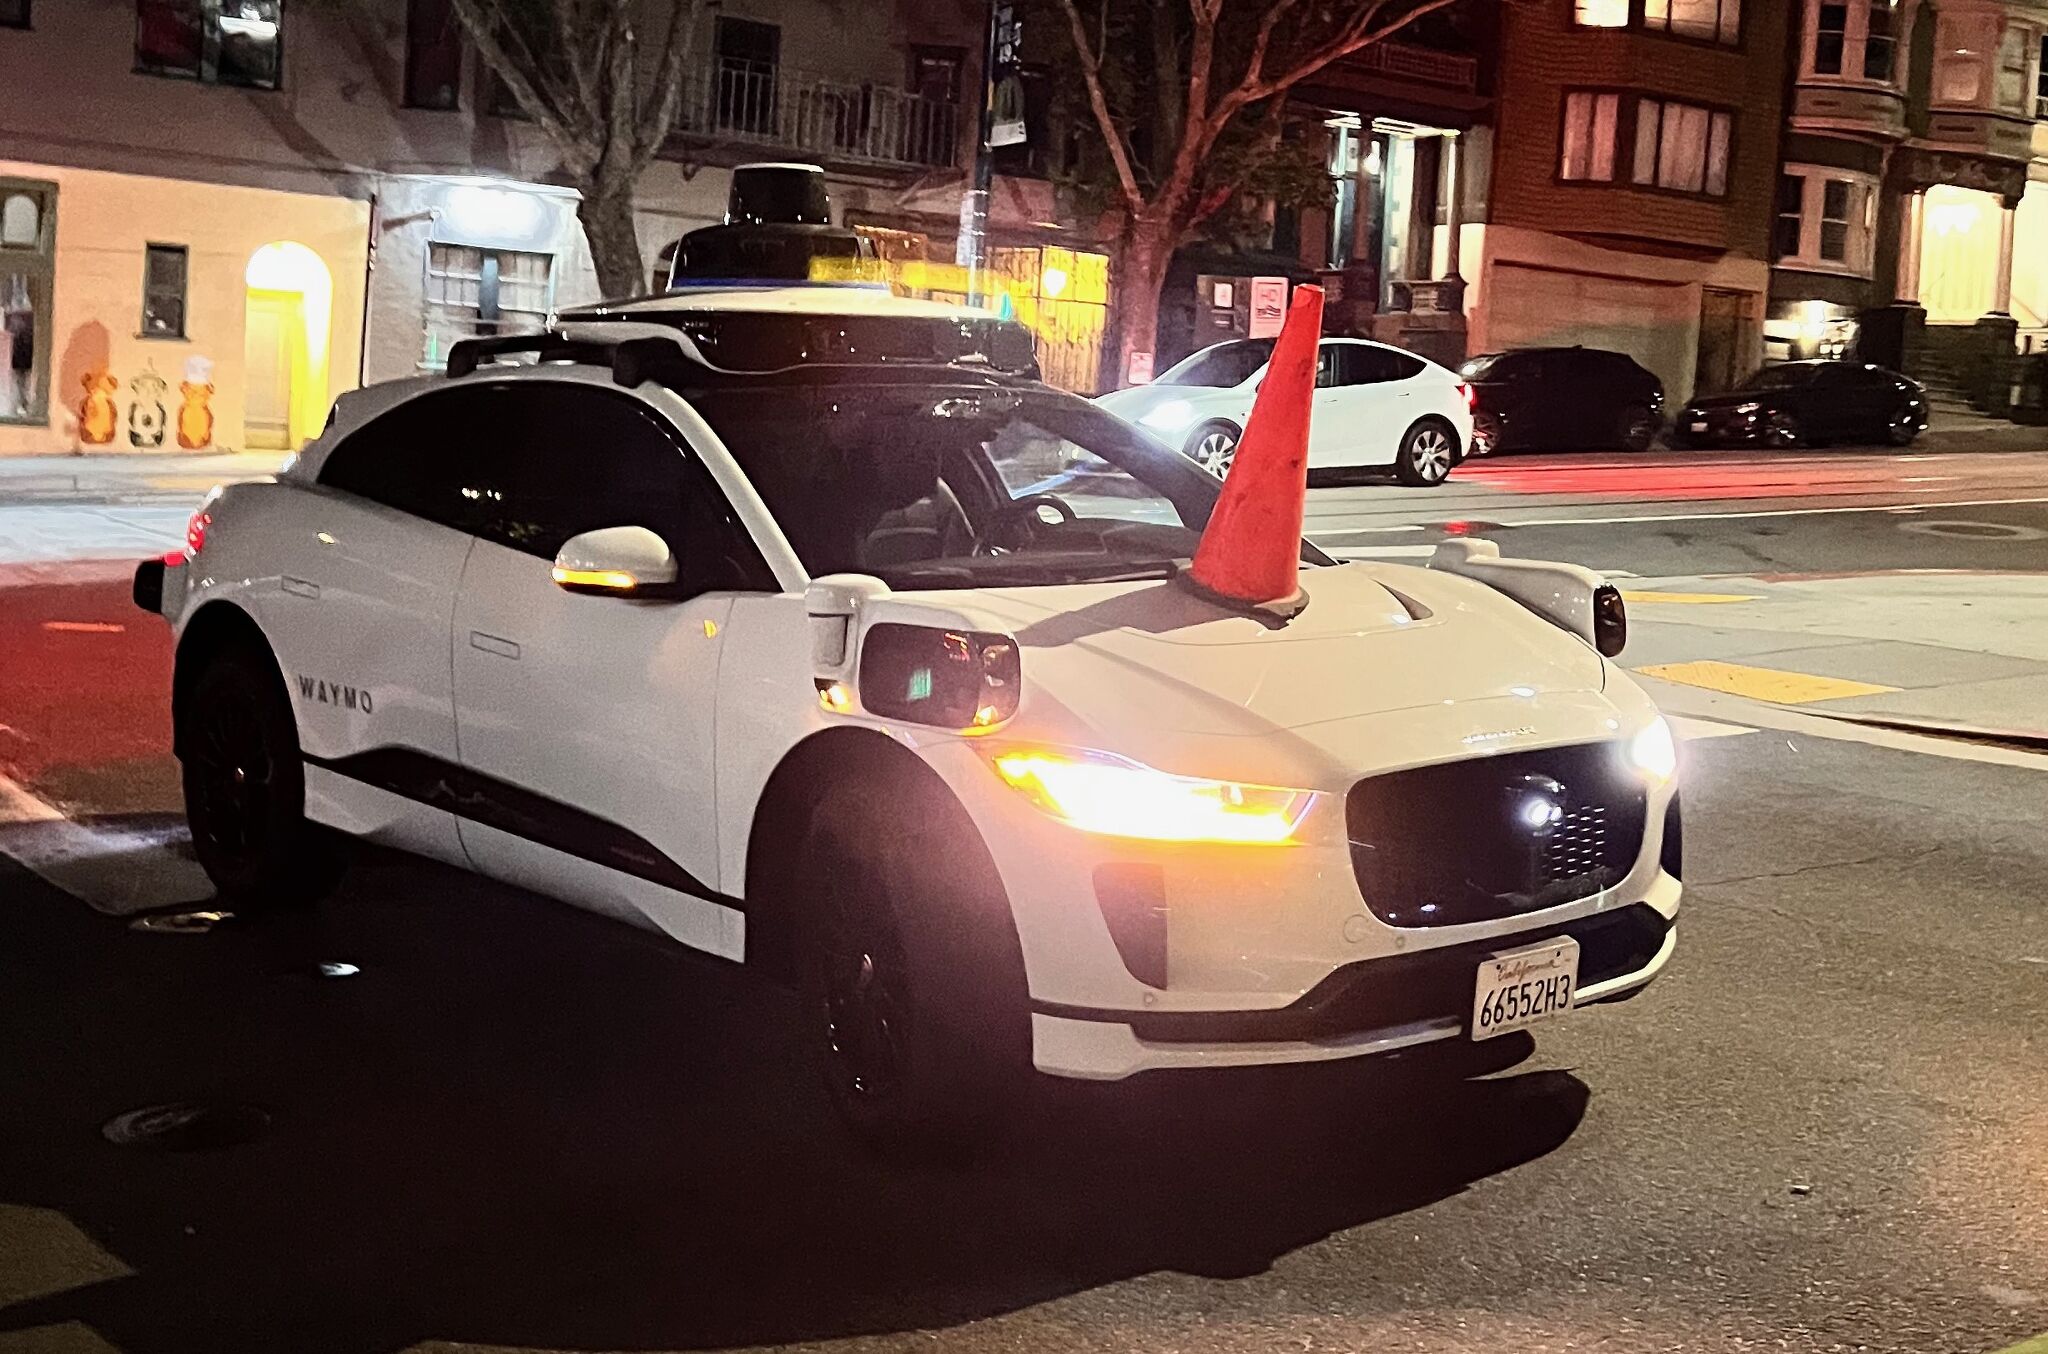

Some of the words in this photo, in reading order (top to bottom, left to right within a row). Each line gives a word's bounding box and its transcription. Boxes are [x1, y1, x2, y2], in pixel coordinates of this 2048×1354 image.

[298, 672, 373, 714] WAYMO
[1497, 957, 1561, 982] California
[1480, 974, 1571, 1027] 66552H3
